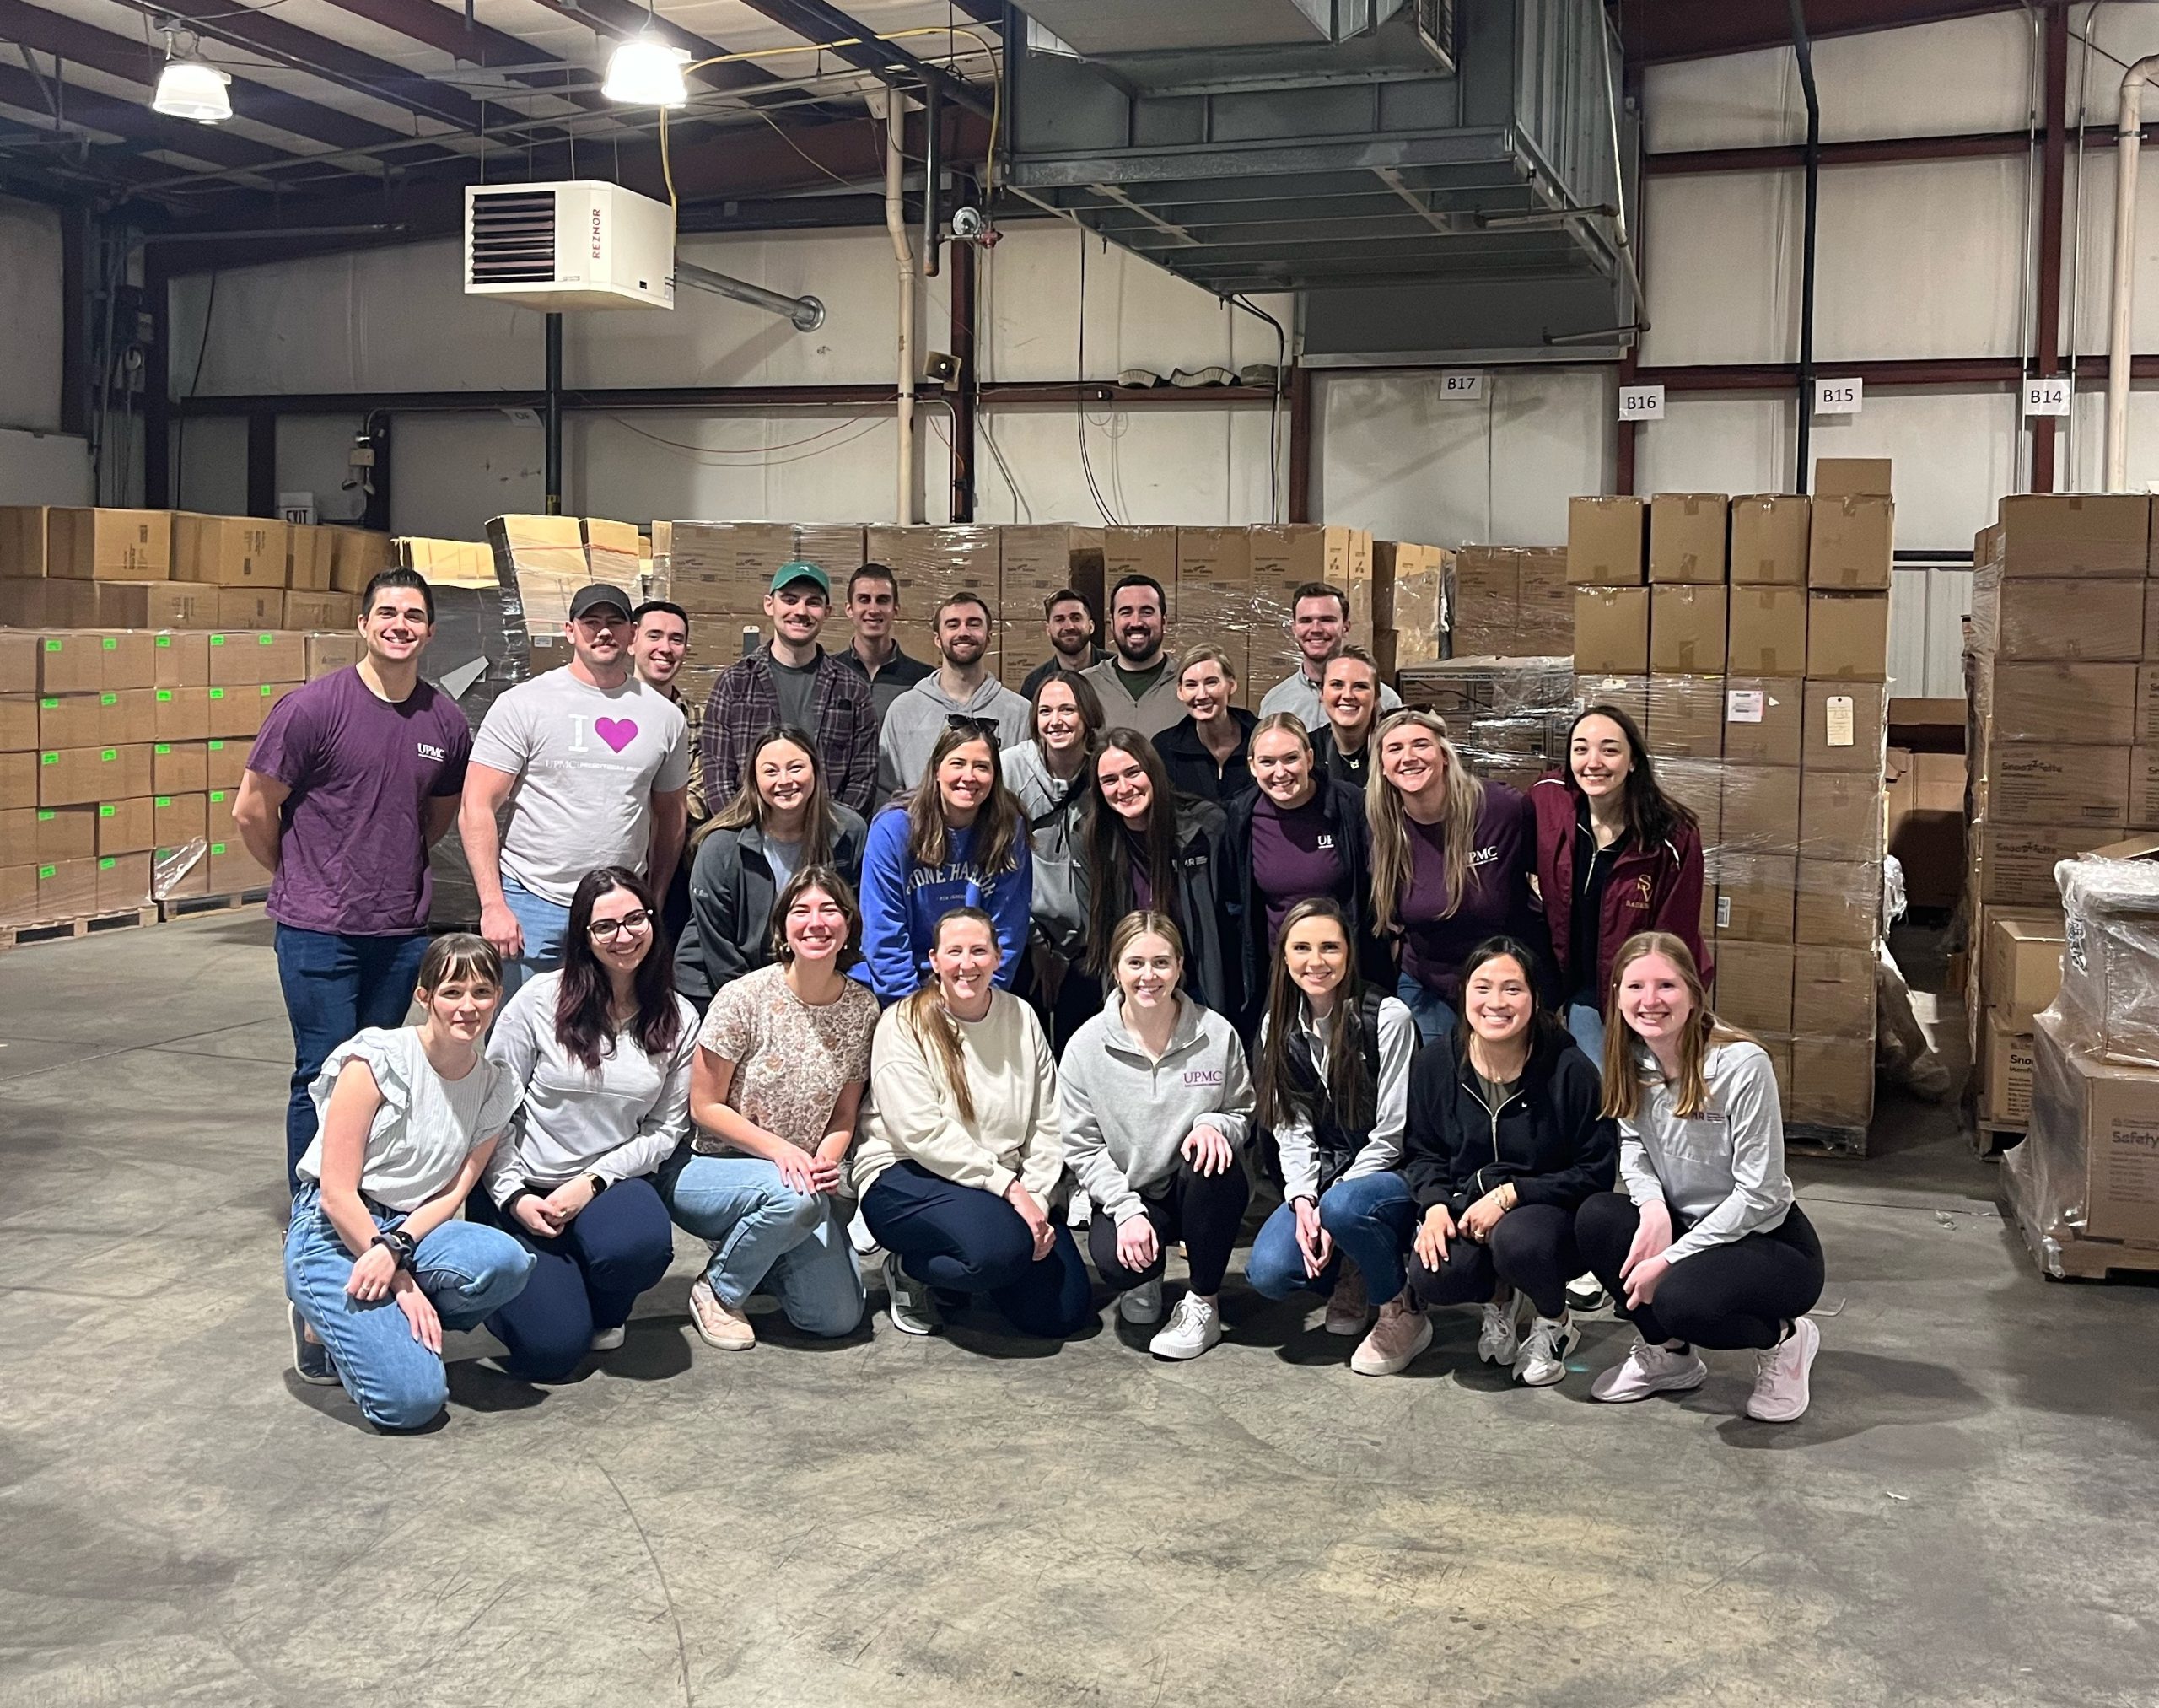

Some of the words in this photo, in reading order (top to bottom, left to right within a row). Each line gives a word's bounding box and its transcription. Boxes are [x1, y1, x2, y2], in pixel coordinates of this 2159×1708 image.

[592, 208, 600, 259] REZNOR
[1447, 377, 1476, 390] B17
[1627, 395, 1656, 409] B16
[1823, 388, 1854, 402] B15
[2031, 390, 2063, 403] B14
[568, 713, 590, 752] I
[417, 742, 445, 759] UPMC
[544, 759, 577, 769] UPMC
[1468, 845, 1498, 864] PMC
[2009, 1053, 2034, 1066] Sno
[1183, 1070, 1224, 1084] UPMC
